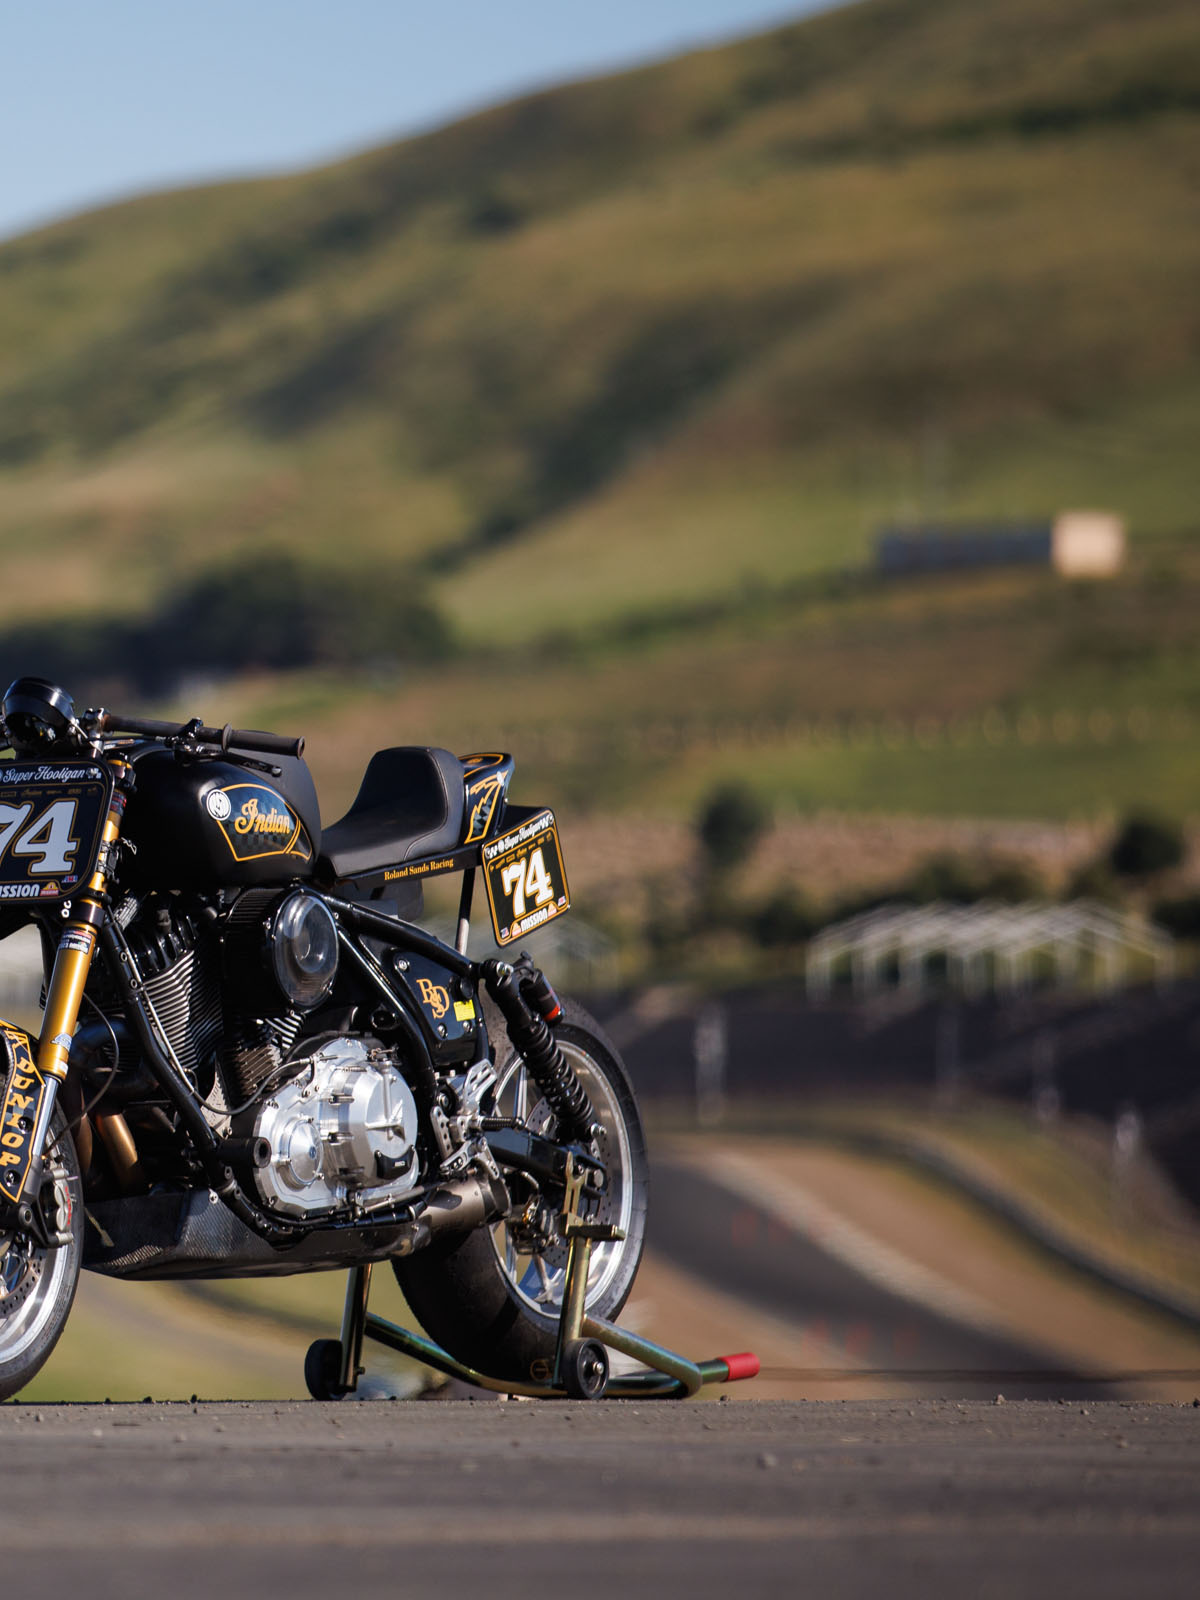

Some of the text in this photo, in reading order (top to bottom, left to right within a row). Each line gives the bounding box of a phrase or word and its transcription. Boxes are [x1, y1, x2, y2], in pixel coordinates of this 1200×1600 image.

[3, 766, 85, 784] Super Hooligan
[234, 798, 290, 834] Indian
[384, 858, 454, 881] Roland Sands Racing
[501, 847, 554, 919] 74
